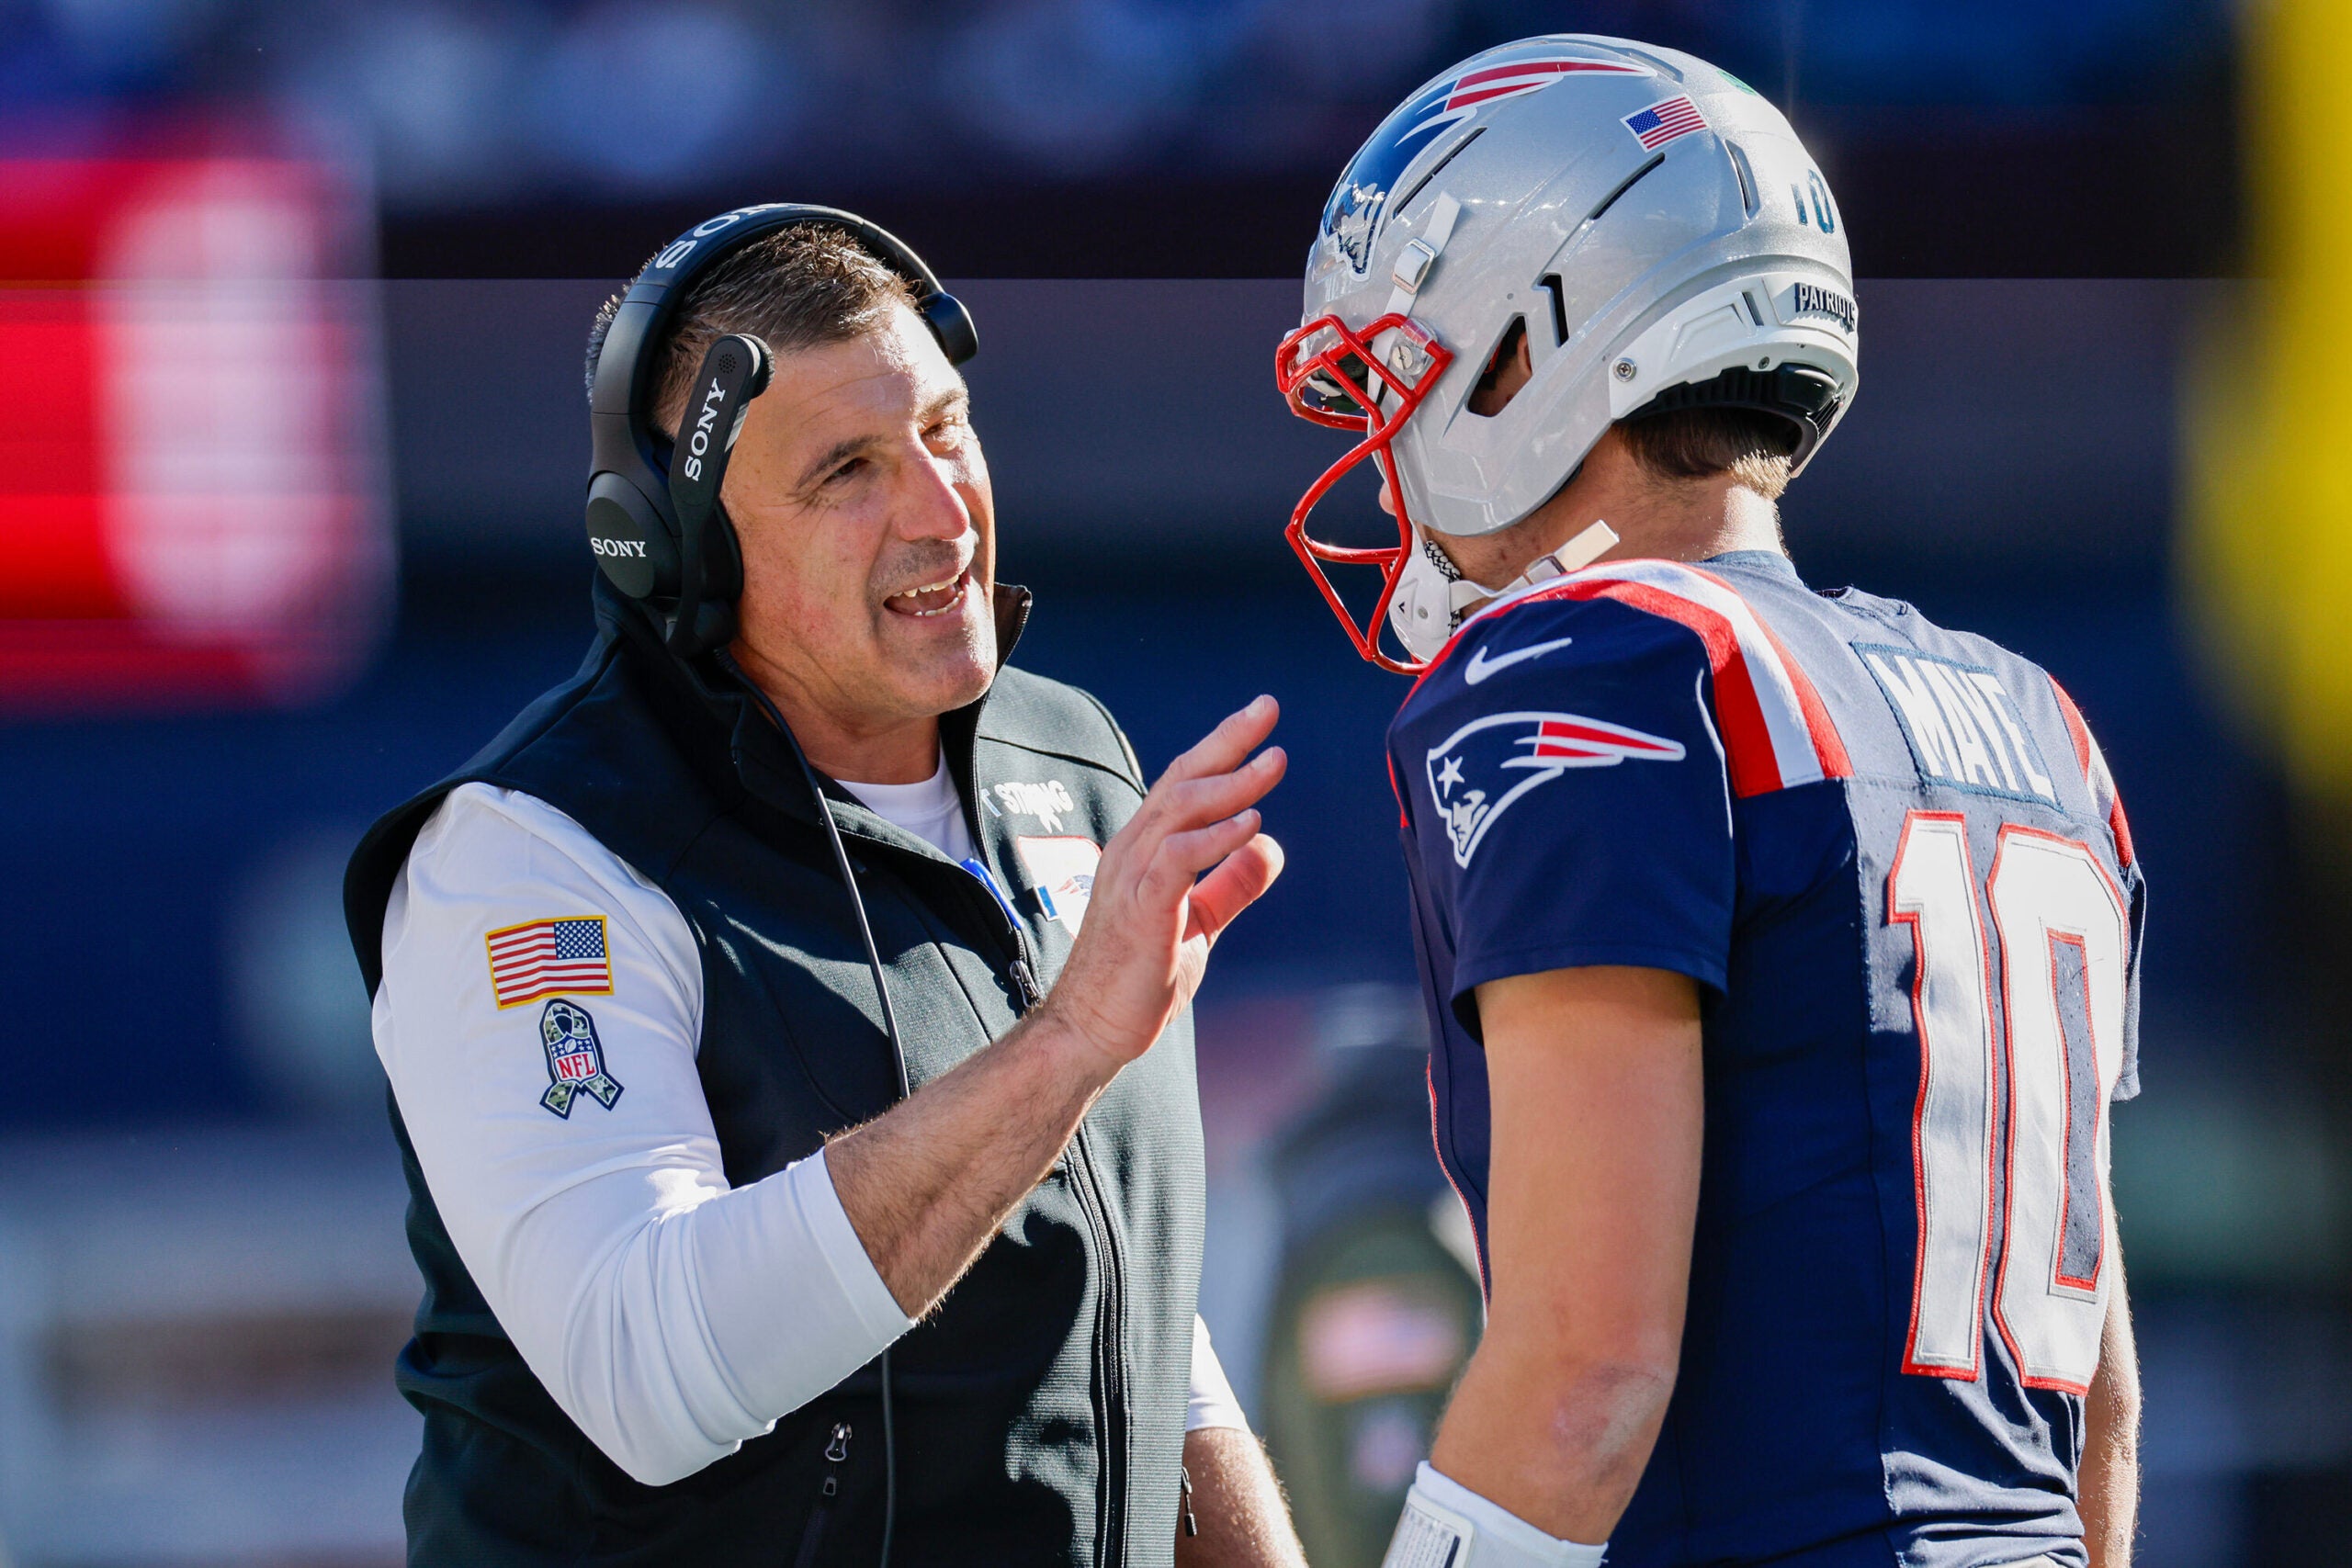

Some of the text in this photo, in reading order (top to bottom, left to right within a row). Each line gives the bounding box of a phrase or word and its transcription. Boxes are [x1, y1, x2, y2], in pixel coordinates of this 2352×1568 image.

[1790, 170, 1835, 234] 10
[684, 378, 726, 481] SONY
[590, 537, 647, 558] SONY
[1865, 653, 2056, 803] MAYE
[556, 1053, 596, 1078] NFL
[1888, 810, 2130, 1396] 10
